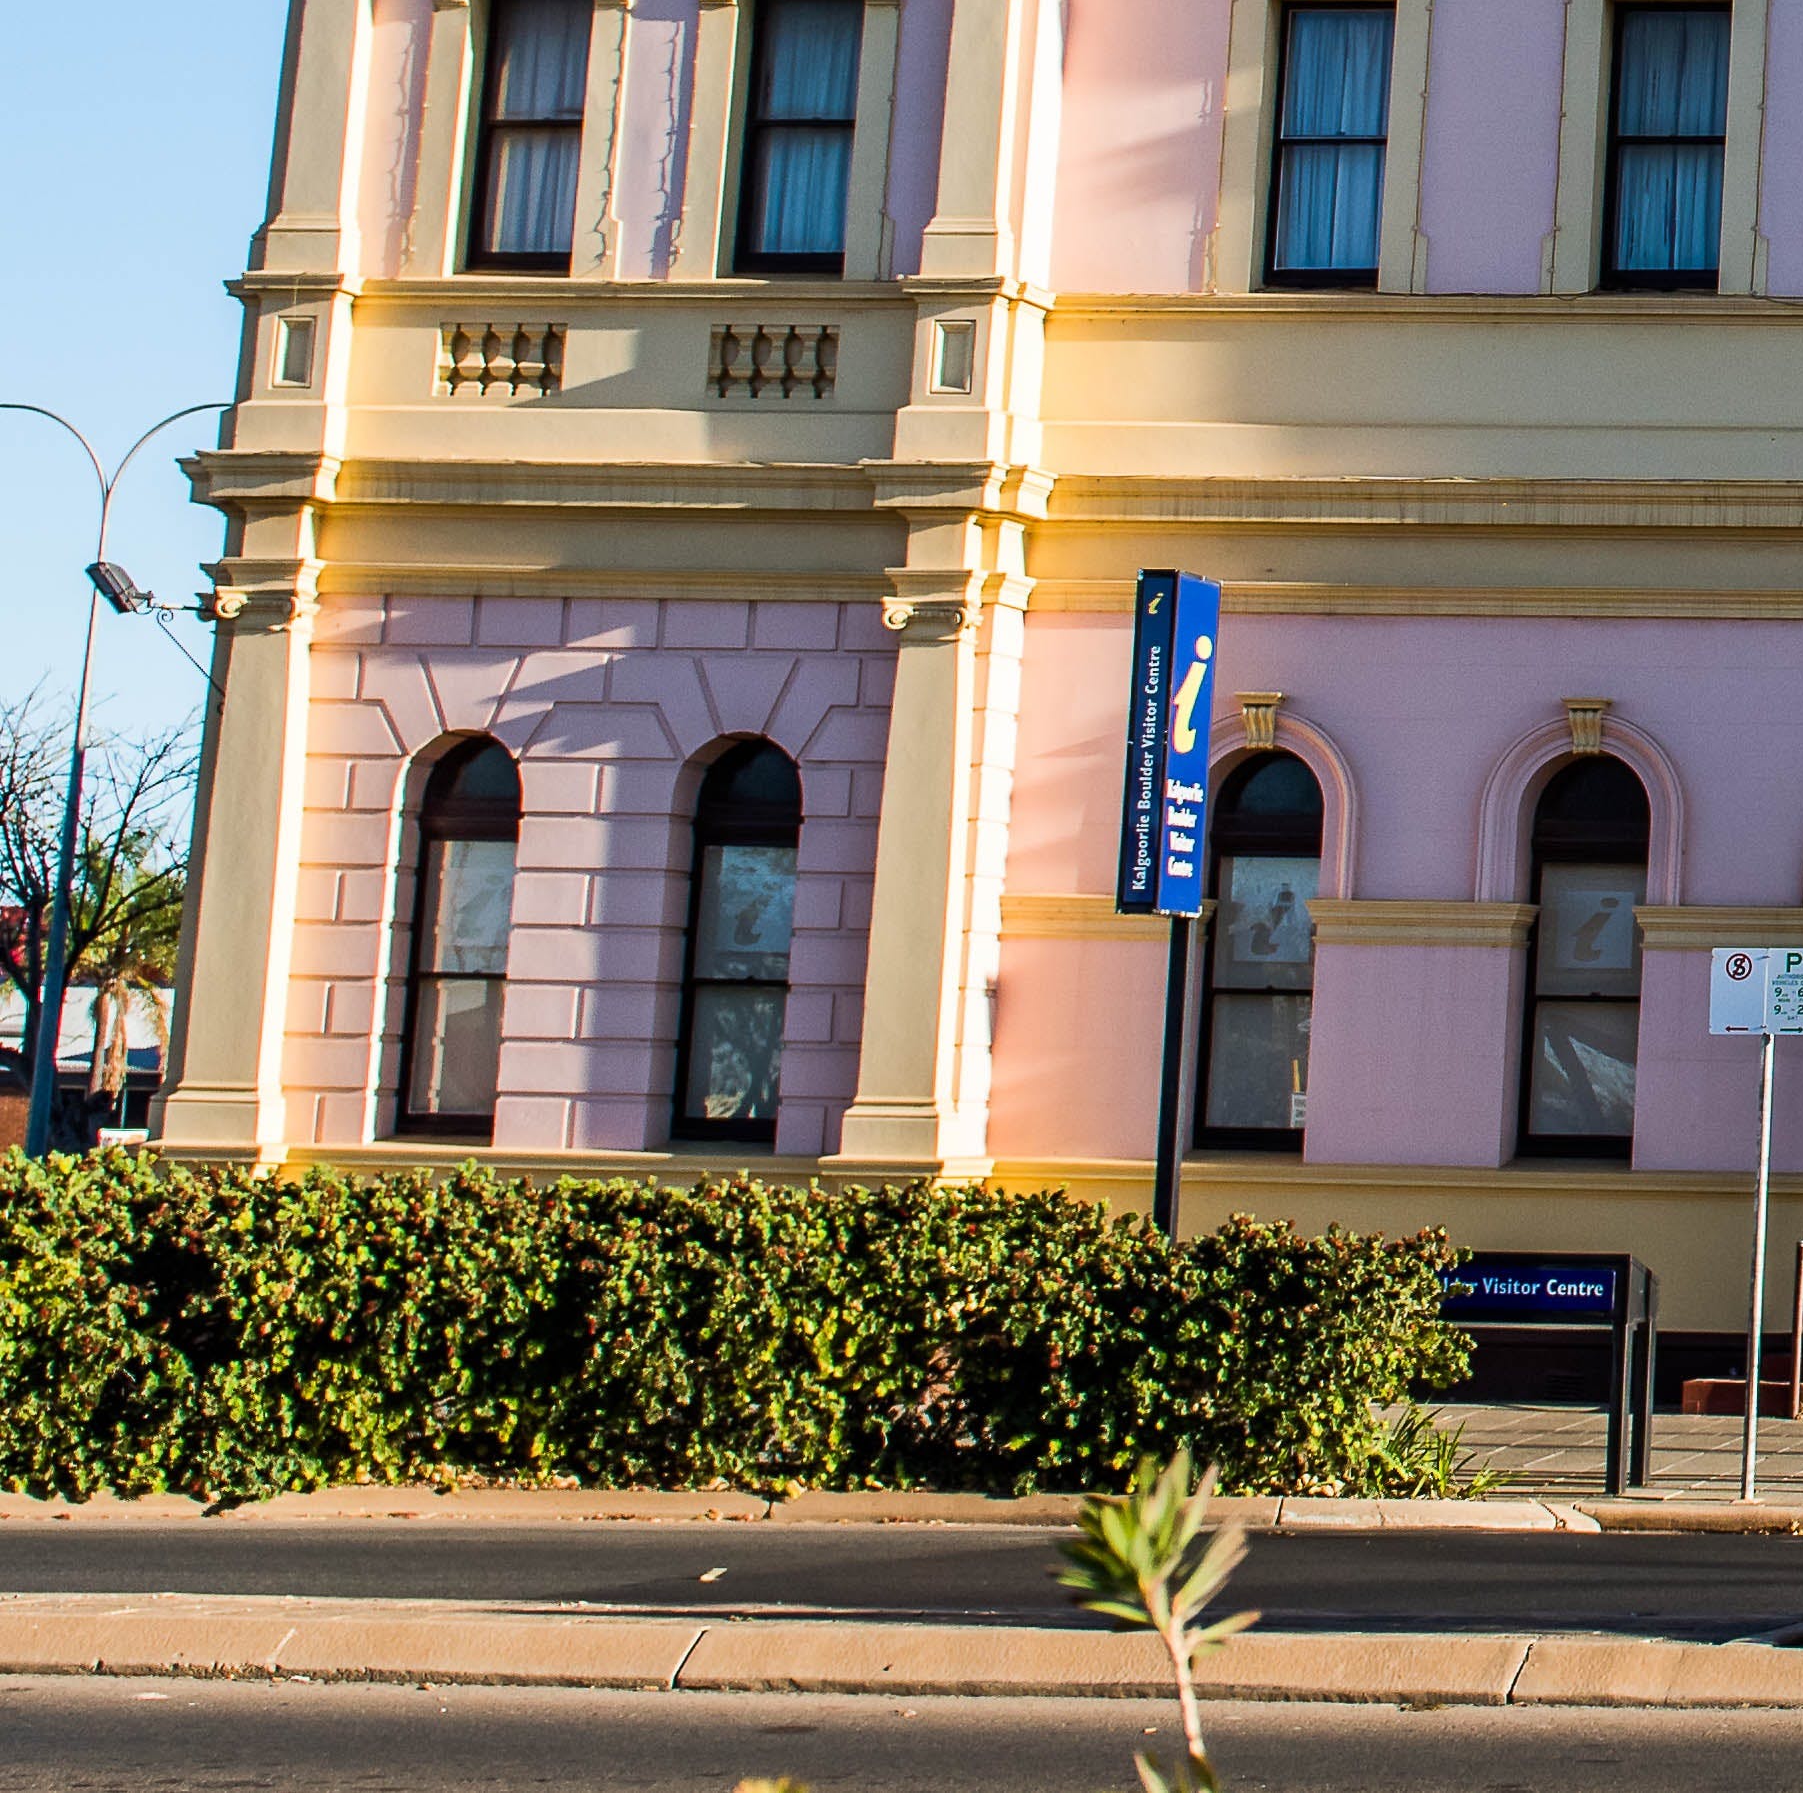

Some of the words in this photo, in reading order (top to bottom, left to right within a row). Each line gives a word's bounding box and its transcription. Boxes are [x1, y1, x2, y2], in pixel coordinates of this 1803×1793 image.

[1145, 646, 1161, 694] Centre
[1141, 700, 1158, 748] Visitor
[1137, 752, 1153, 809] Boulder
[1132, 815, 1150, 890] Kalgoorlie
[1786, 953, 1803, 973] P
[1483, 1277, 1541, 1295] Visitor
[1546, 1278, 1604, 1296] Centre
